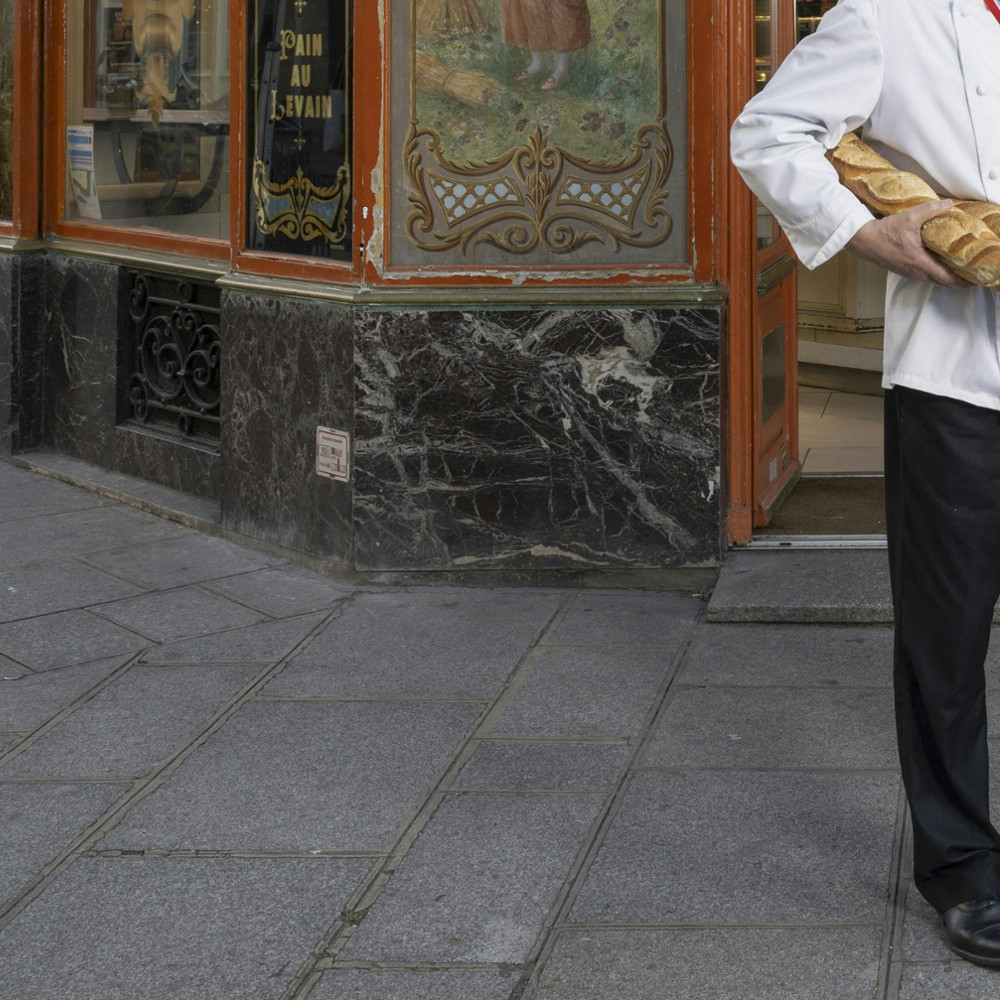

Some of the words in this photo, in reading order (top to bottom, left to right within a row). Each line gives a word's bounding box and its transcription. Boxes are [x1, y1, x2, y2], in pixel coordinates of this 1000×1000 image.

[279, 28, 323, 61] PAIN
[290, 63, 312, 88] AU
[270, 88, 333, 121] LEVAIN
